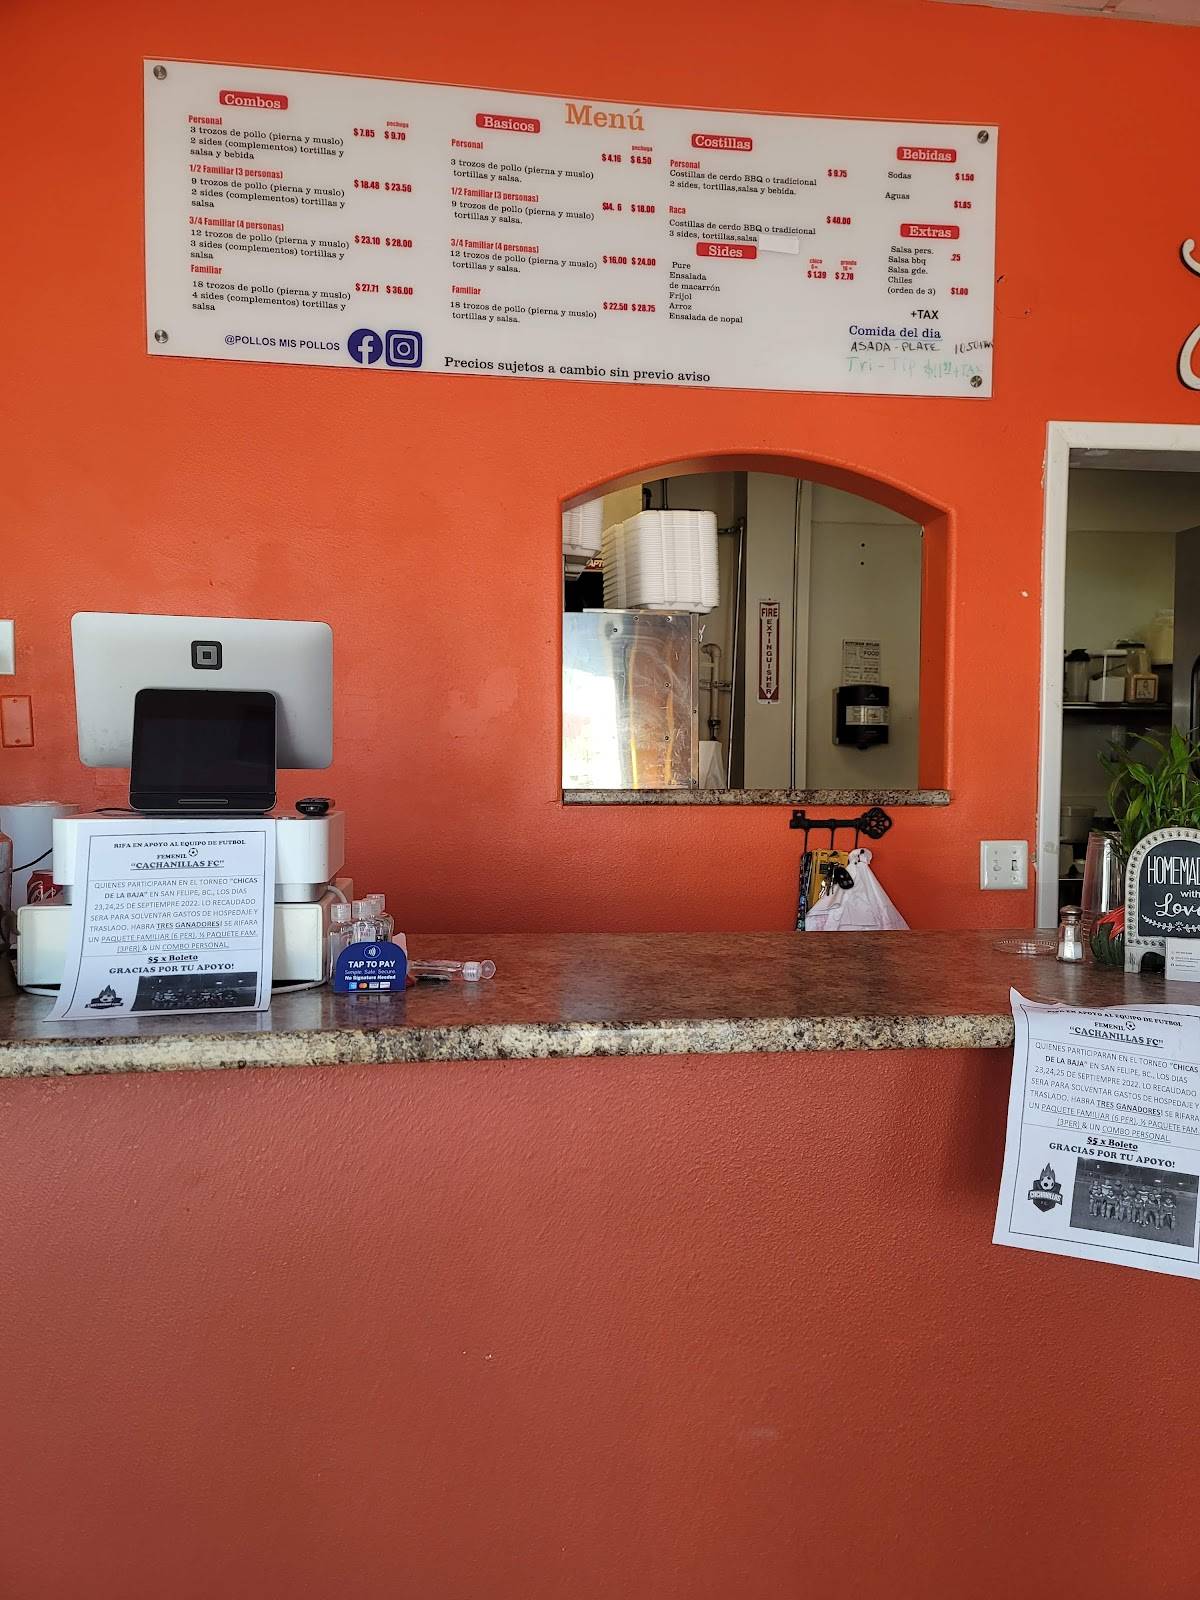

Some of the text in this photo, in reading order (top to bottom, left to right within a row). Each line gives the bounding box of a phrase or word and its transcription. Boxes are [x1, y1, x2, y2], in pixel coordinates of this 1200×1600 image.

[224, 93, 281, 109] Combos
[188, 115, 222, 125] Personal
[565, 103, 644, 131] Menú
[482, 116, 535, 132] Basicos
[199, 126, 227, 135] trozos
[243, 130, 266, 139] pollo
[269, 132, 302, 141] (pierna
[304, 136, 310, 144] y
[313, 137, 343, 146] muslo)
[199, 137, 222, 146] sides
[225, 139, 297, 153] (complementos)
[300, 146, 336, 155] tortillas
[338, 150, 344, 158] y
[451, 138, 483, 149] Personal
[695, 136, 751, 151] Costillas
[190, 148, 213, 156] salsa
[224, 150, 254, 159] bebida
[902, 149, 952, 162] Bebidas
[459, 160, 485, 168] trozos
[500, 164, 522, 172] pollo
[524, 165, 555, 175] (pierna
[565, 171, 594, 180] muslo)
[670, 159, 700, 169] Personal
[453, 170, 488, 179] tortillas
[498, 174, 522, 182] salsa.
[670, 169, 705, 178] Costillas
[744, 174, 763, 183] BBQ
[773, 177, 817, 186] tradicional
[888, 171, 911, 179] Sodas
[677, 181, 700, 189] sides,
[767, 187, 796, 195] bebida.
[884, 192, 910, 200] Aguas
[669, 205, 686, 214] Raca
[189, 216, 284, 231] 3/4 Familiar (4 personas)
[909, 225, 952, 238] Extras
[708, 245, 743, 258] Sides
[891, 245, 912, 255] Salsa
[672, 261, 691, 269] Pure
[911, 257, 926, 266] bbq
[191, 264, 222, 274] Familiar
[887, 266, 928, 275] Salsa gde.
[669, 271, 707, 280] Ensalada
[887, 276, 912, 284] Chiles
[669, 281, 678, 289] de
[887, 286, 913, 294] (orden
[927, 288, 935, 296] 3)
[669, 291, 691, 301] Frijol
[669, 302, 692, 310] Arroz
[669, 312, 706, 321] Ensalada
[720, 316, 742, 324] nopal
[911, 309, 939, 319] +TAX
[849, 325, 941, 338] Comida del dia
[225, 335, 340, 351] @POLLOS MIS POLLOS
[444, 356, 710, 382] Precios sujetos a cambio sin previo aviso
[761, 608, 778, 618] FIRE
[765, 619, 773, 695] EXTINGUISHER
[181, 964, 196, 972] TU
[366, 960, 377, 968] TO
[1035, 1042, 1065, 1052] QUIENES
[1067, 1046, 1116, 1060] PARTICIPARAN
[1118, 1054, 1127, 1062] EN
[1139, 1057, 1167, 1068] TORNEO
[1045, 1055, 1055, 1063] DE
[1101, 1064, 1115, 1072] SAN
[1157, 1072, 1169, 1081] LOS
[1172, 1075, 1188, 1083] DIAS
[1096, 1100, 1163, 1117] TRES GANADORES!
[1086, 1136, 1138, 1152] $5 x Boleto
[1049, 1142, 1175, 1168] GRACIAS POR TU APOYO!
